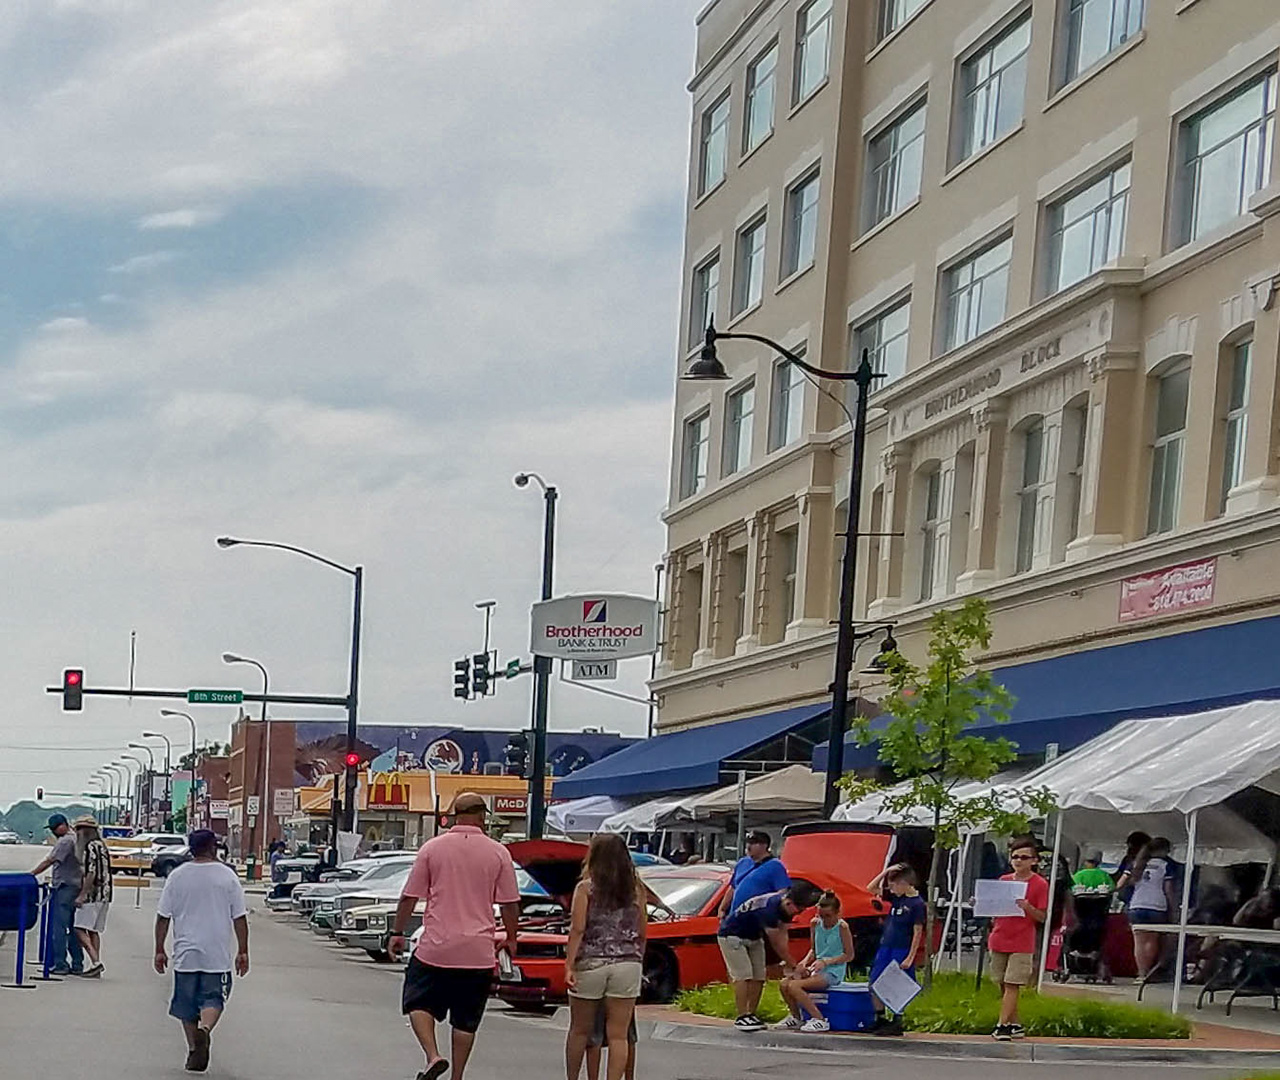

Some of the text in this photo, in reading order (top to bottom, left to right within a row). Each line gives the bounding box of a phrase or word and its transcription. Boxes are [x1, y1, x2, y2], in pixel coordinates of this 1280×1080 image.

[546, 624, 643, 638] Brotherhood
[558, 638, 628, 648] BANK & TRUST
[577, 663, 609, 677] ATM
[211, 693, 238, 702] Street
